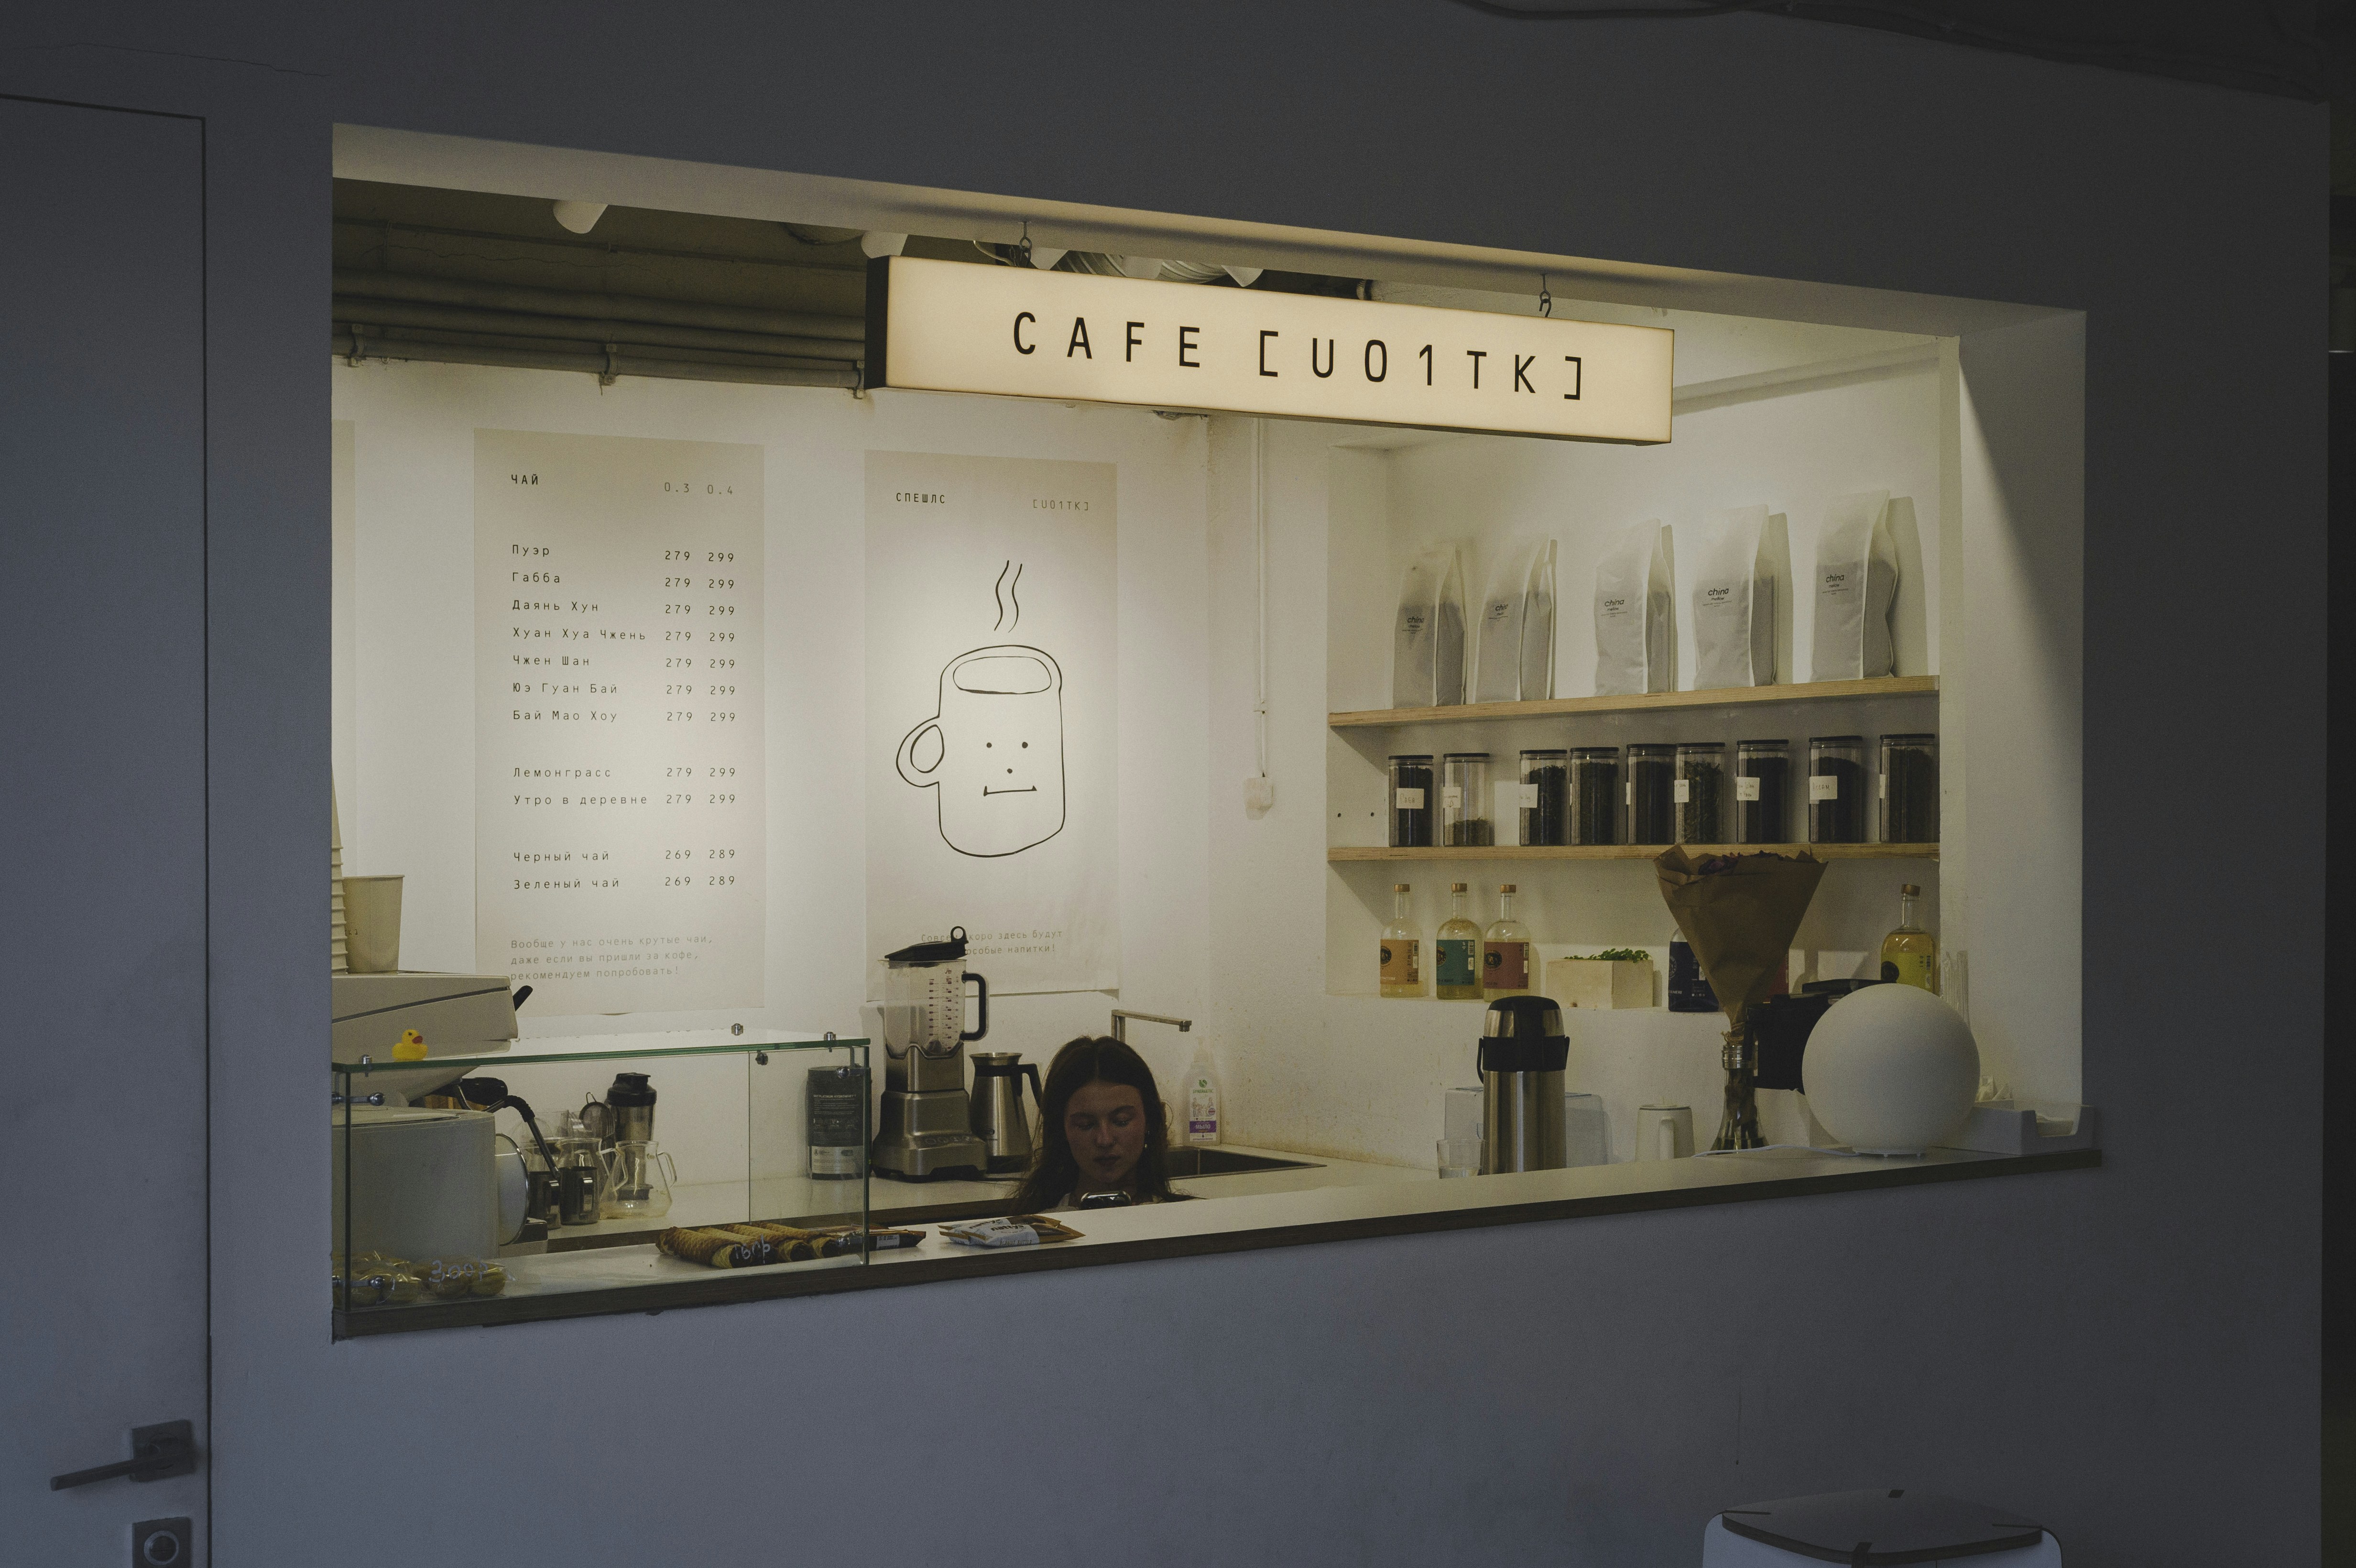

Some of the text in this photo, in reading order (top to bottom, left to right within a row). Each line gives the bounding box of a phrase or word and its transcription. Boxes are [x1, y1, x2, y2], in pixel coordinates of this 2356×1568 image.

[1014, 312, 1200, 368] CAFE
[511, 474, 733, 495] ЧАЙ 0.3 0.4
[896, 492, 945, 504] СПЕШЛС
[512, 544, 734, 562] Пуэр 279 299
[512, 572, 734, 589] Габба 279 299
[1826, 574, 1844, 583] china
[512, 599, 734, 615] Даянь Хун 279 299
[513, 627, 735, 642] Хуан Хуа Чжень 279 299
[513, 655, 735, 669] Чжен Шан 279 299
[513, 682, 735, 695] Юэ Гуан Бай 279 299
[513, 710, 735, 723] Бай Мао Хоу 279 299
[513, 767, 735, 779] Лемонграсс 279 299
[514, 795, 552, 806] Утро
[579, 796, 647, 806] деревне
[666, 794, 691, 804] 279
[709, 794, 735, 804] 299
[513, 849, 735, 863] Черный чай 269 289
[514, 875, 735, 890] Зеленый чай 269 289
[1032, 929, 1062, 939] будут
[511, 938, 554, 949] Вообще
[560, 940, 566, 949] у
[639, 937, 680, 947] крутые
[1008, 944, 1055, 953] напитки!
[511, 957, 539, 965] даже
[599, 954, 640, 963] пришли
[665, 951, 698, 960] кофе,
[511, 966, 678, 982] рекомендуем попробовать!
